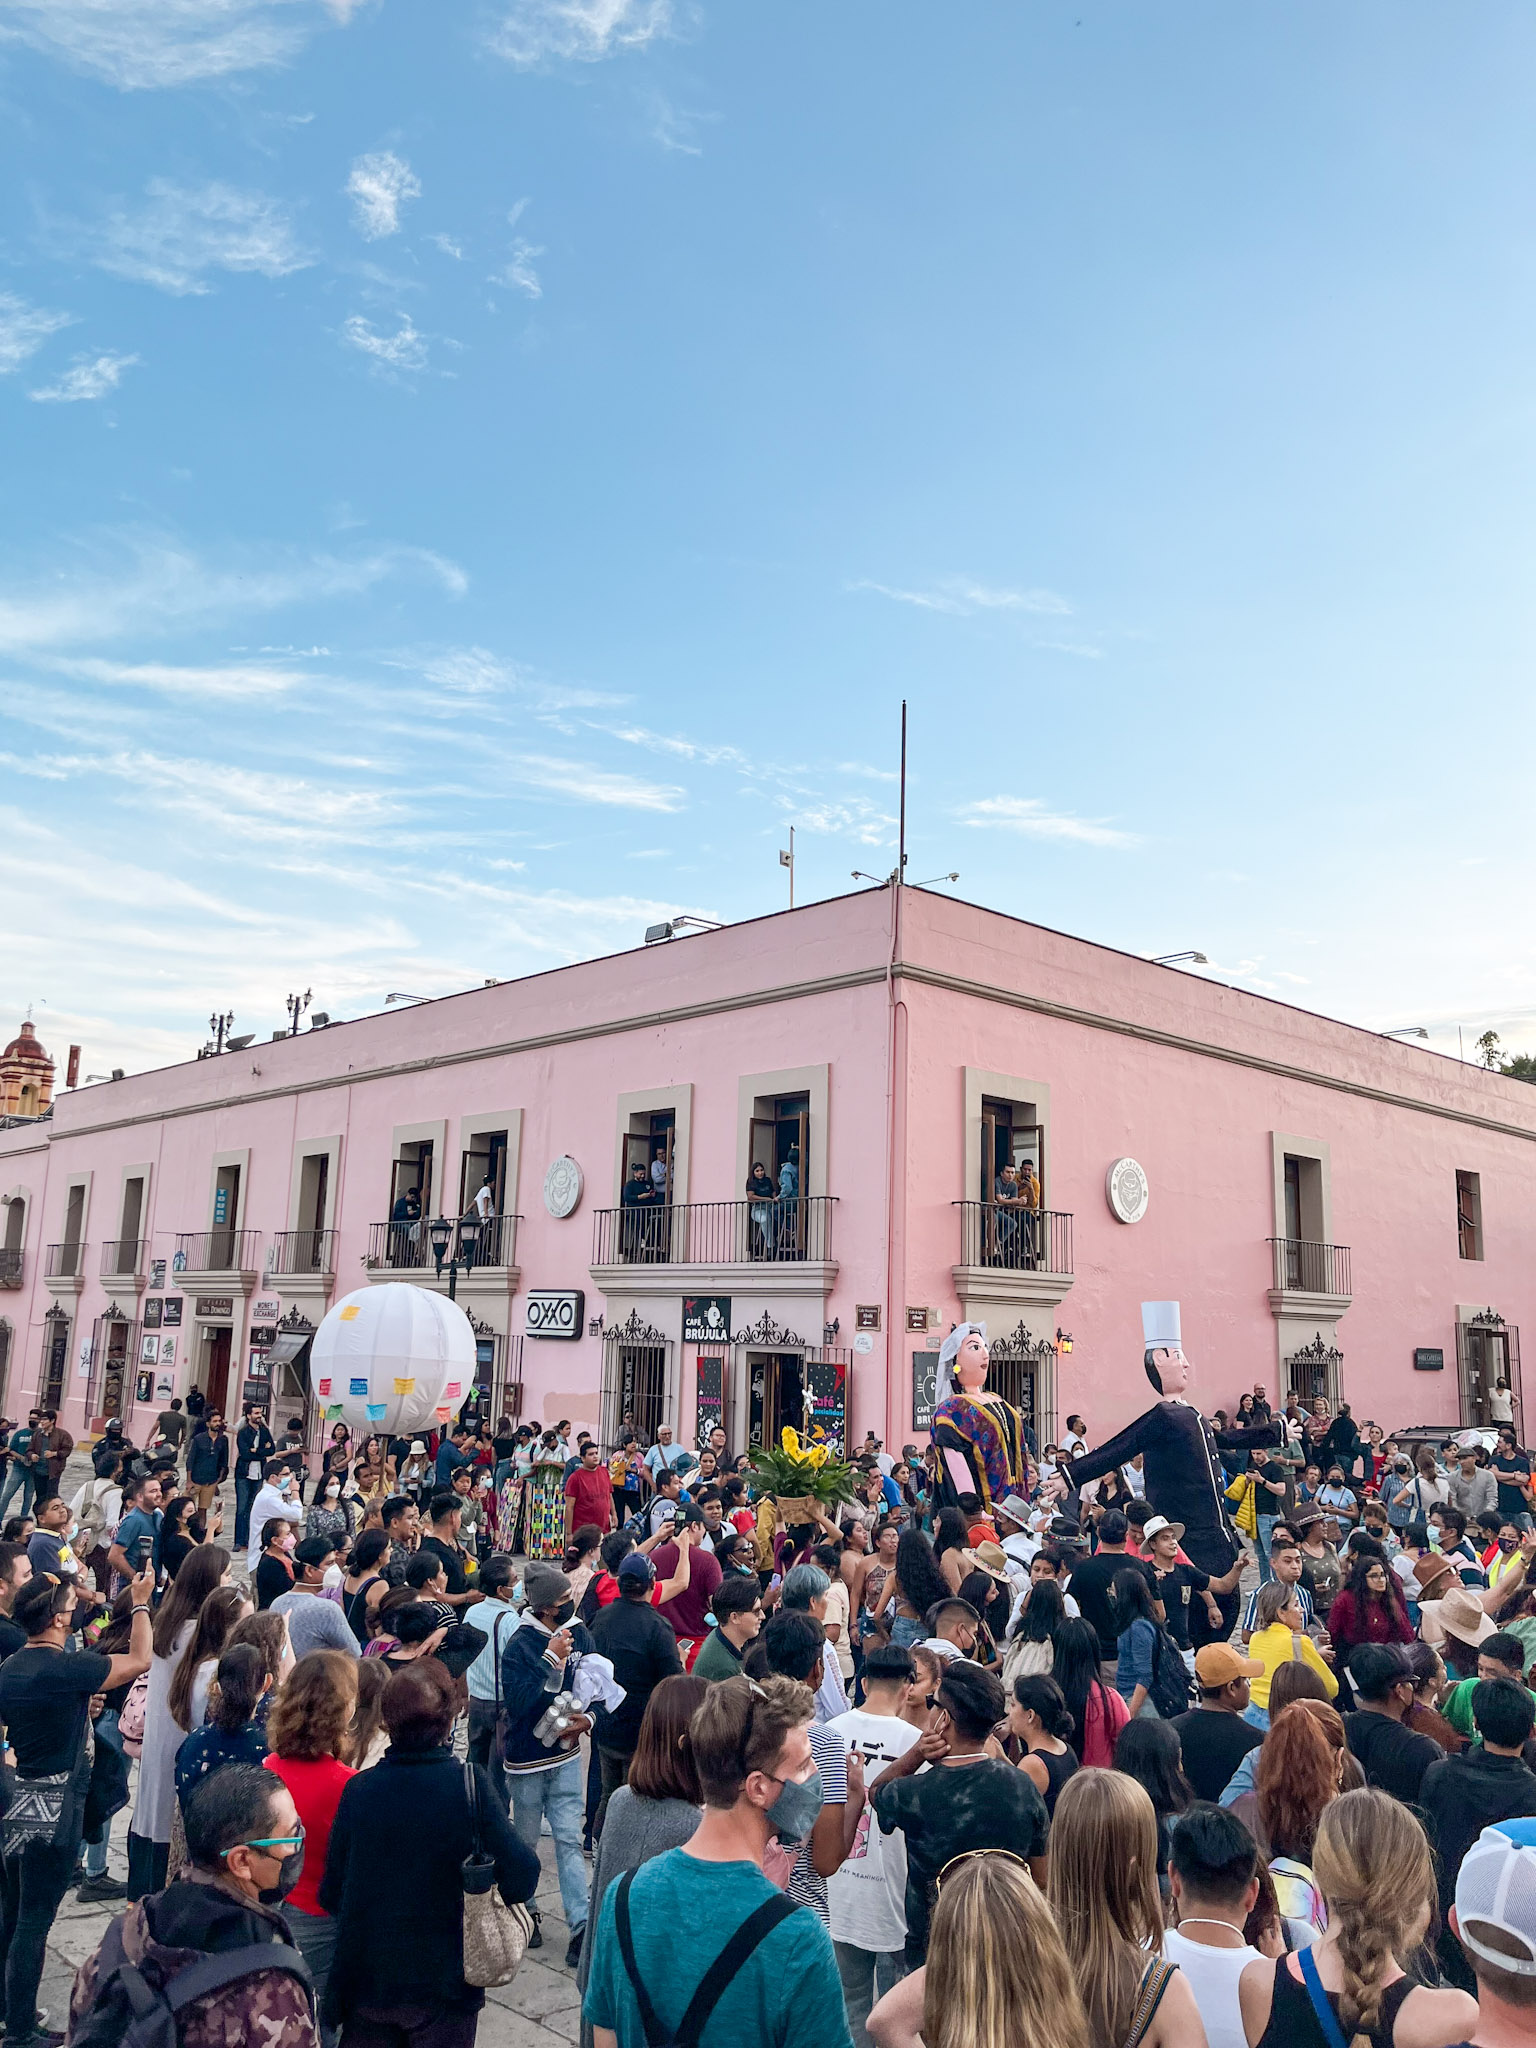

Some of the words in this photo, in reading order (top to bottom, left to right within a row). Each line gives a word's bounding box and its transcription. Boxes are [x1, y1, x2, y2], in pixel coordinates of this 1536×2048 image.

[215, 1188, 227, 1223] TOURS
[527, 1299, 573, 1328] OXXO
[686, 1316, 702, 1326] CAFÉ
[685, 1325, 728, 1341] BRÚJULA
[699, 1397, 721, 1405] OAXACA
[917, 1405, 930, 1413] CAFÉ
